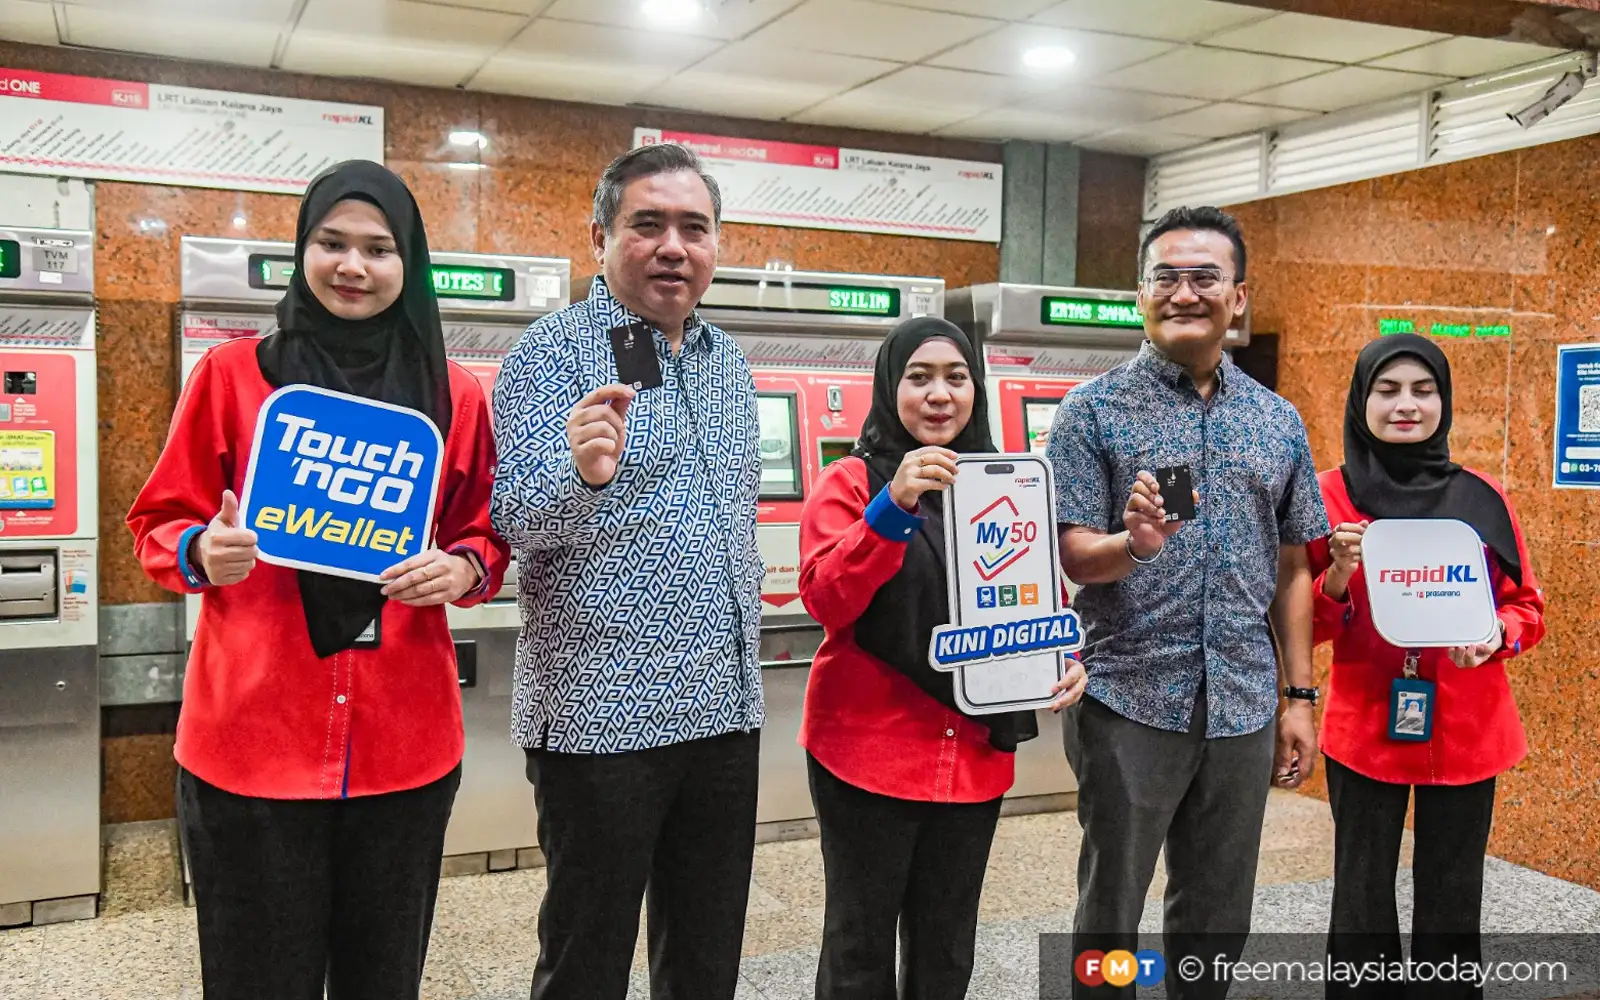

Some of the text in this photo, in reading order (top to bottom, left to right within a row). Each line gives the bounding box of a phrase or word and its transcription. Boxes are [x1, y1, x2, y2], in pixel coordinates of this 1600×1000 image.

[44, 250, 68, 260] TVM
[1098, 305, 1144, 322] SAHAJ
[276, 413, 424, 479] Touch
[255, 504, 415, 555] eWallet
[779, 565, 795, 573] dan
[1379, 565, 1478, 587] rapidKL
[1425, 590, 1461, 598] prasarana
[938, 617, 1074, 657] KINI DIGITAL
